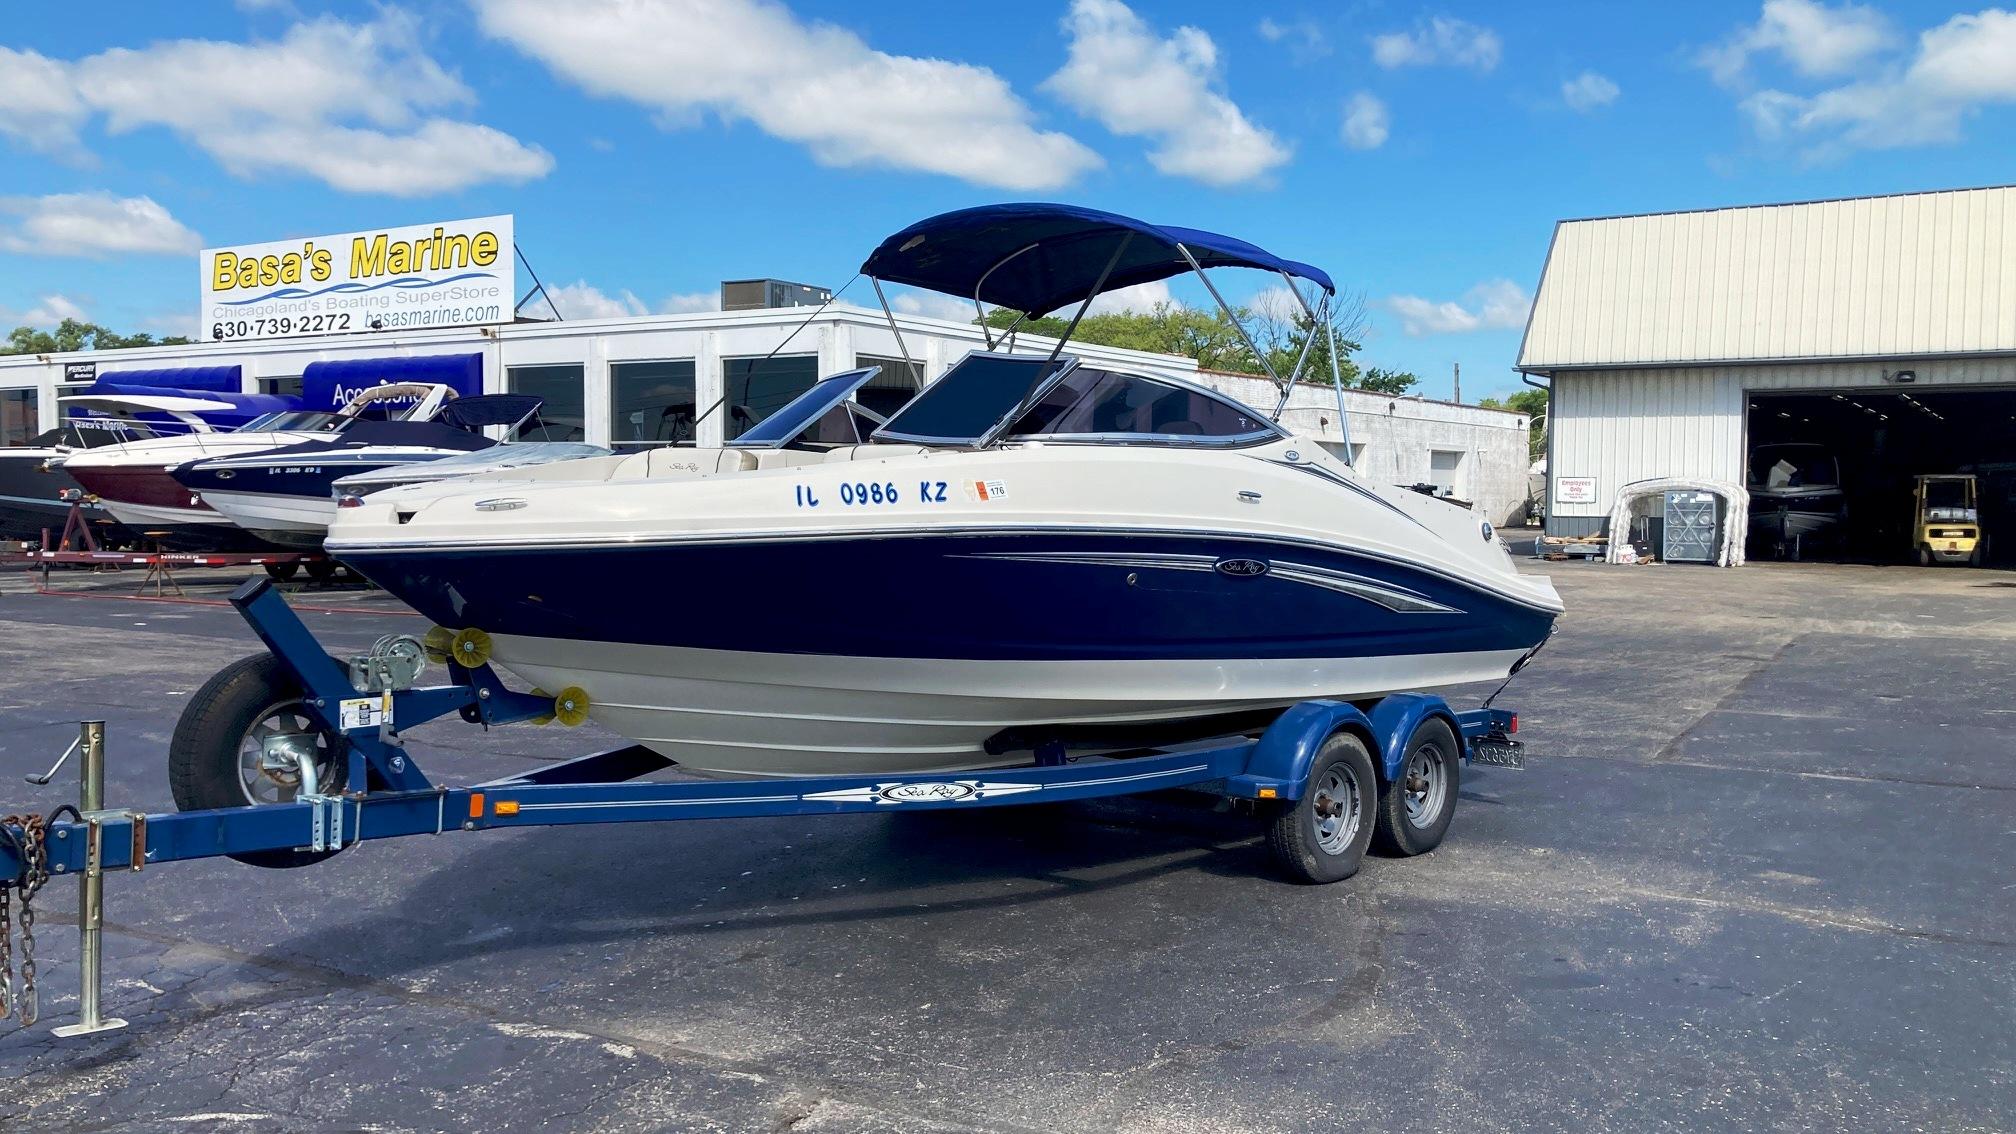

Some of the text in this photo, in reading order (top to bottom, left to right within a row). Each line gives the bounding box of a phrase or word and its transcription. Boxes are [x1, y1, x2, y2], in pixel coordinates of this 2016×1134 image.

[212, 227, 499, 291] Basa's Marine
[213, 285, 500, 319] Chicagoland's Boating SuperStore
[796, 480, 948, 507] IL 0986 KZ
[990, 486, 1005, 495] 176
[1224, 560, 1261, 574] Sea Ray
[897, 784, 959, 799] Sea Ray
